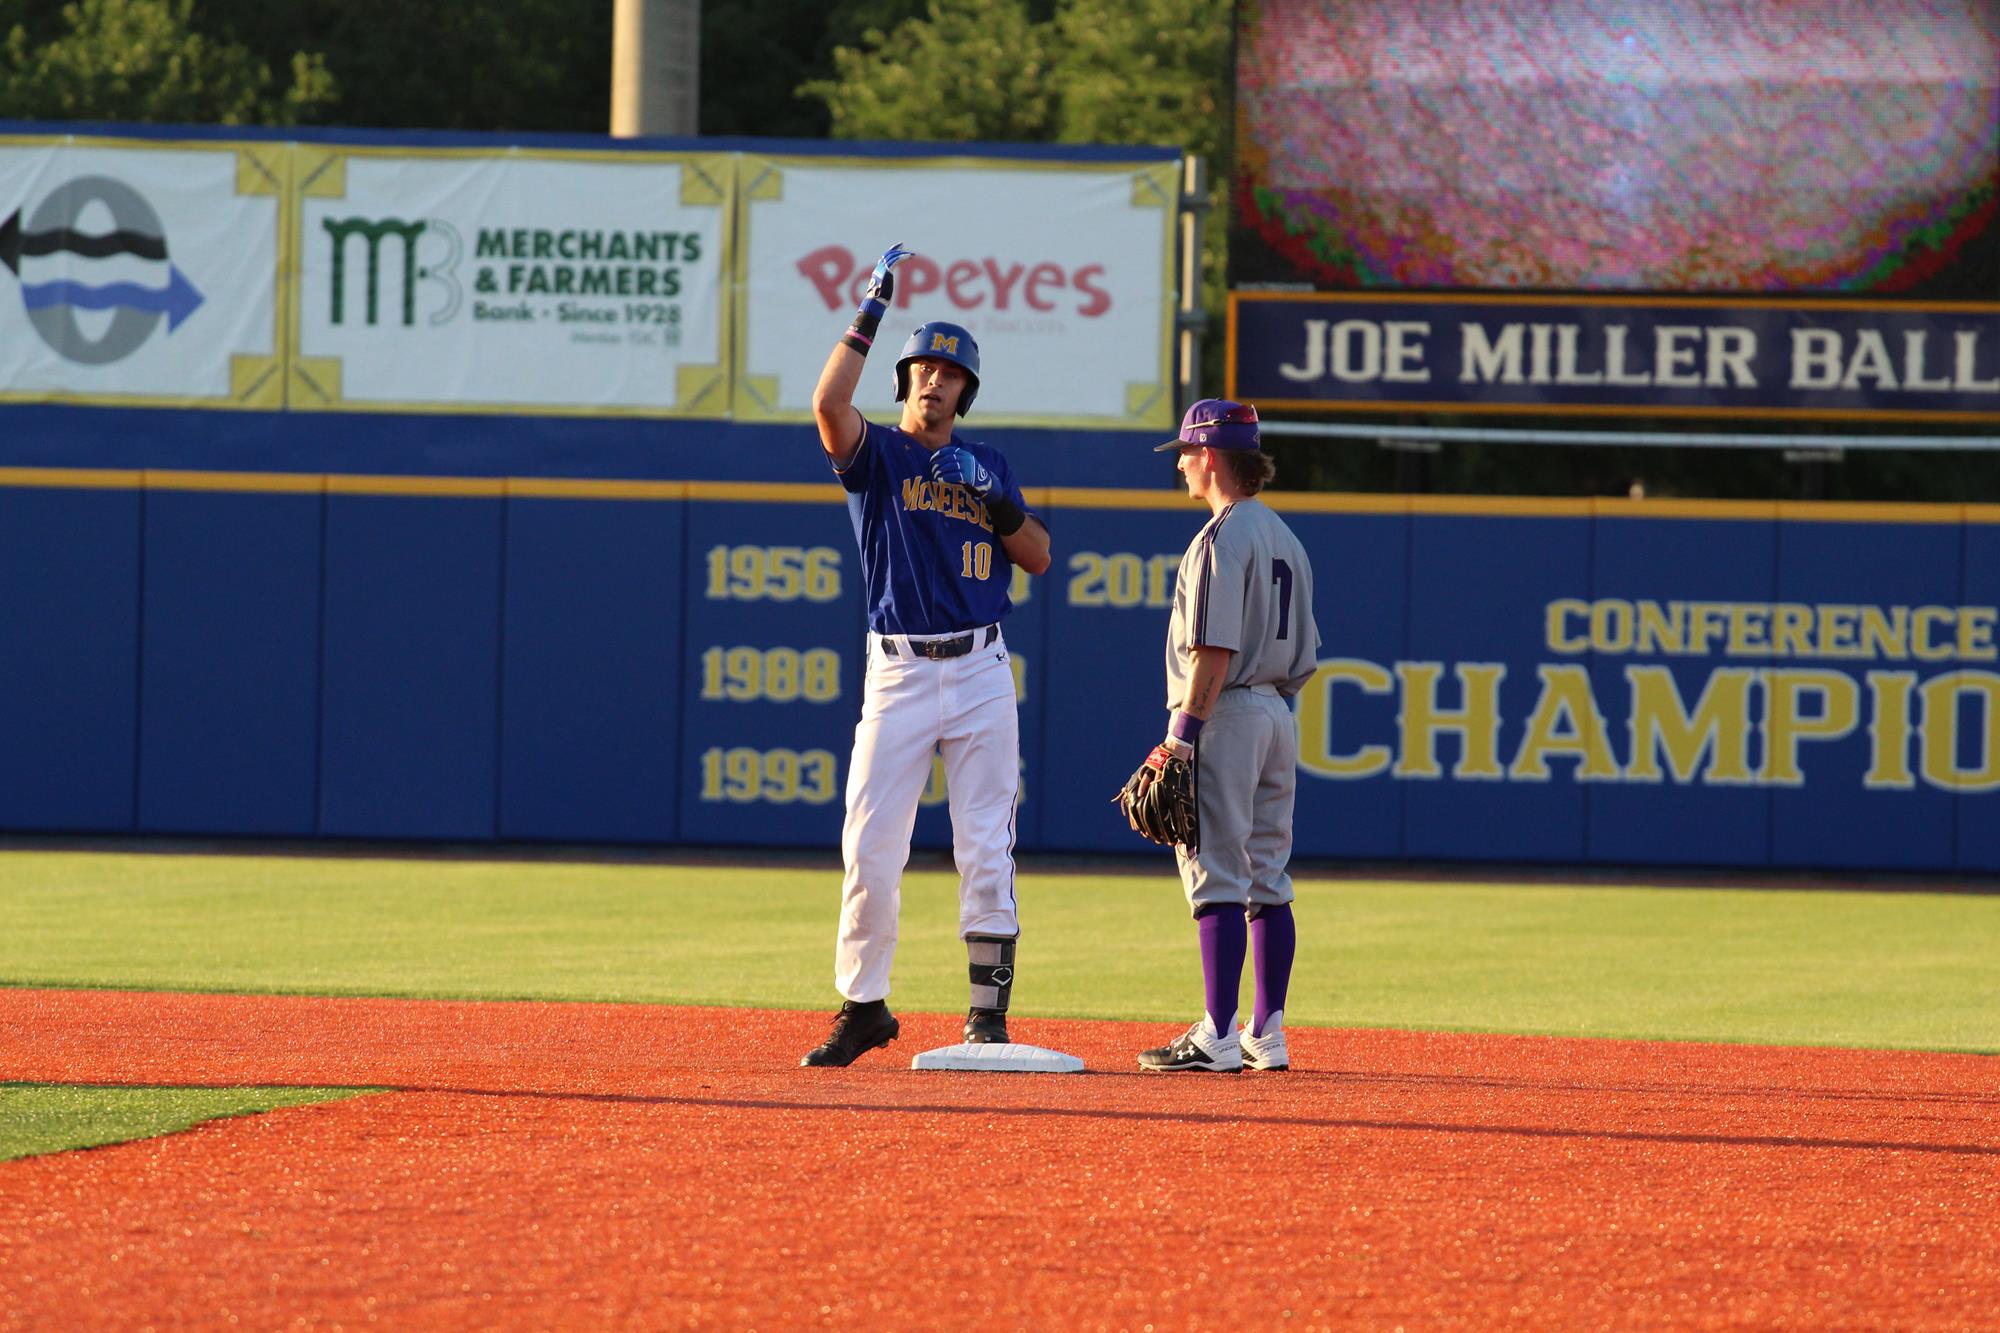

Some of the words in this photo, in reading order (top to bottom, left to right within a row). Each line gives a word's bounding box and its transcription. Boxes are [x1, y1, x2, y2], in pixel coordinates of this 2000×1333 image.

[474, 228, 702, 262] MERCHANTS
[475, 266, 499, 293] &
[508, 265, 682, 297] FARMERS
[474, 302, 534, 322] Bank
[557, 303, 618, 324] Since
[625, 304, 682, 325] 1928
[929, 332, 959, 355] M
[1278, 319, 1431, 383] JOE
[1459, 322, 1759, 389] MILLER
[1789, 326, 2000, 392] BALL
[706, 545, 842, 602] 1956
[961, 541, 993, 581] 10
[1272, 557, 1293, 640] 7
[1545, 598, 1998, 661] CONFERENCE
[702, 646, 841, 703] 1988
[1294, 657, 2000, 792] CHAMPIO
[701, 747, 838, 804] 1993
